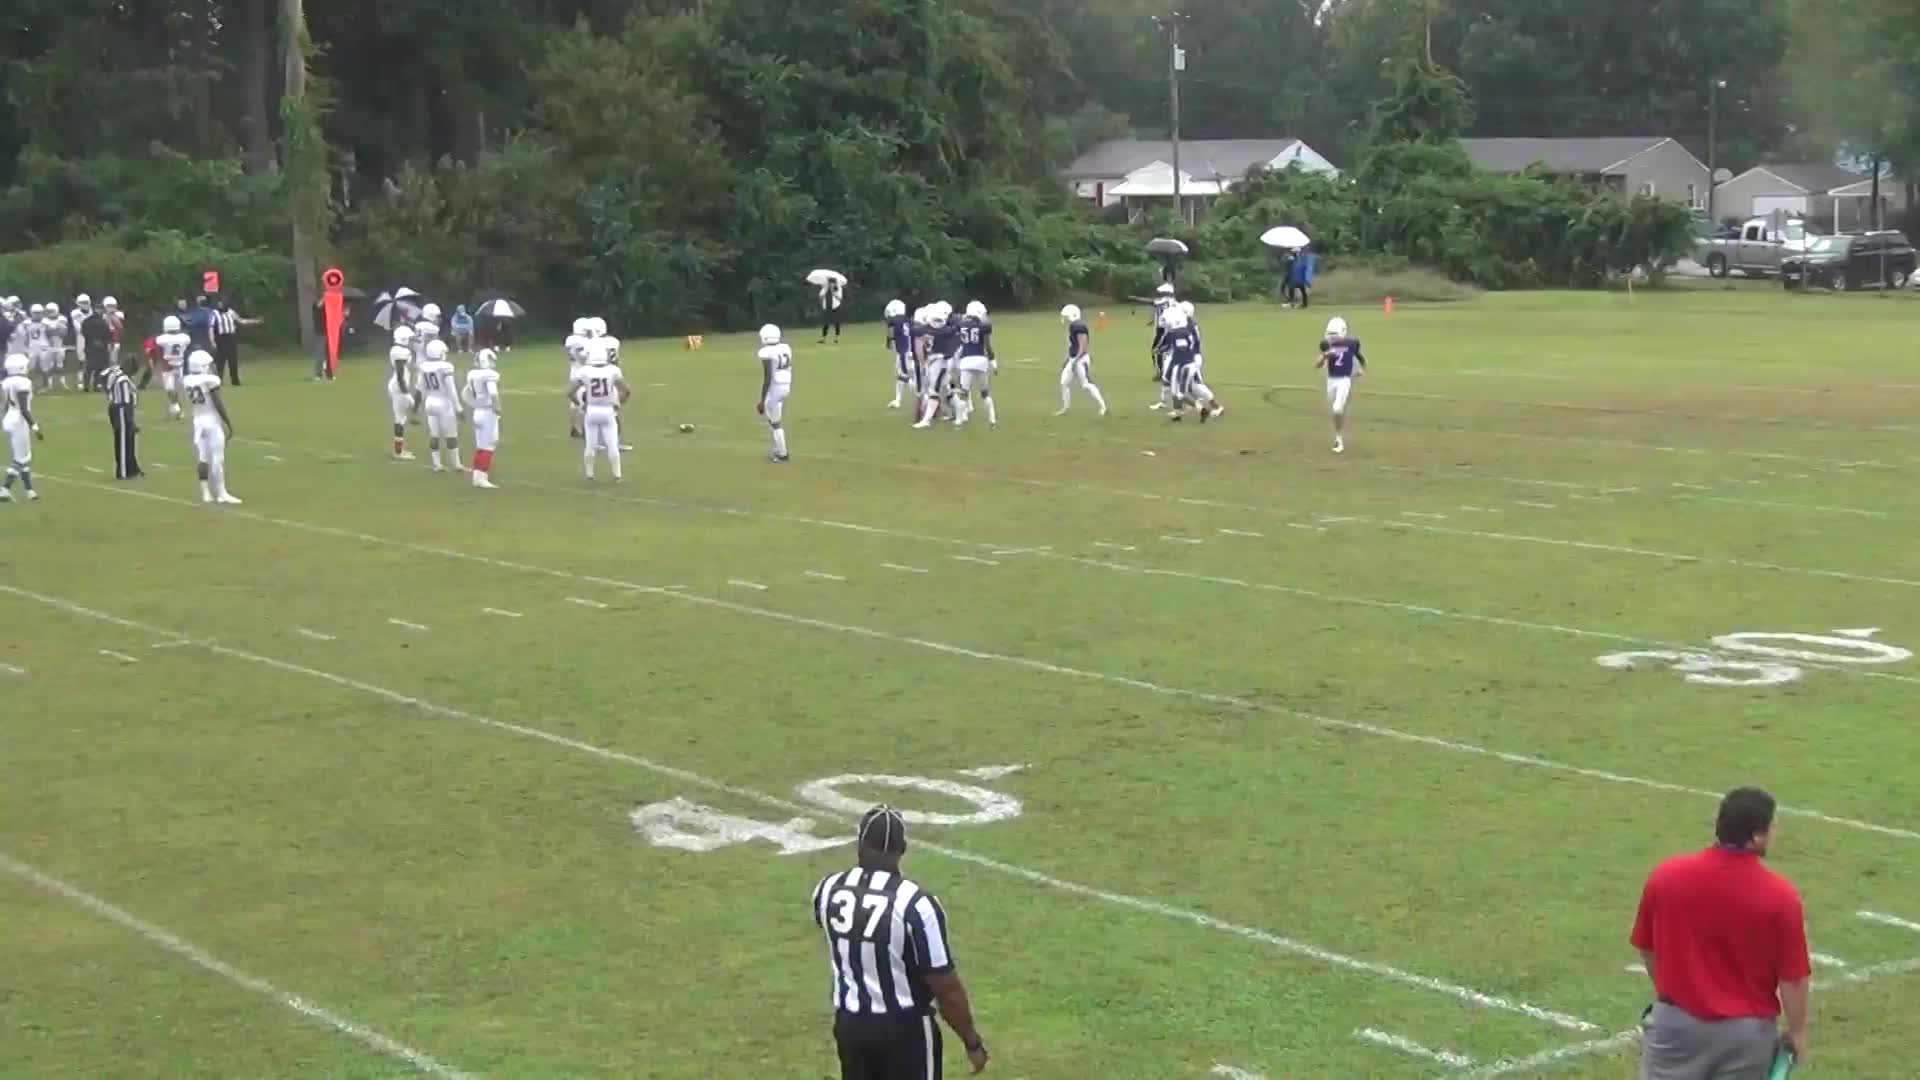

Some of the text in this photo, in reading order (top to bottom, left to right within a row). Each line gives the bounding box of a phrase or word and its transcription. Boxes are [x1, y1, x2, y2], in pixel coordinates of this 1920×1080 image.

[424, 372, 440, 391] 10
[590, 377, 609, 397] 21
[1596, 633, 1913, 686] 30
[830, 889, 889, 938] 37
